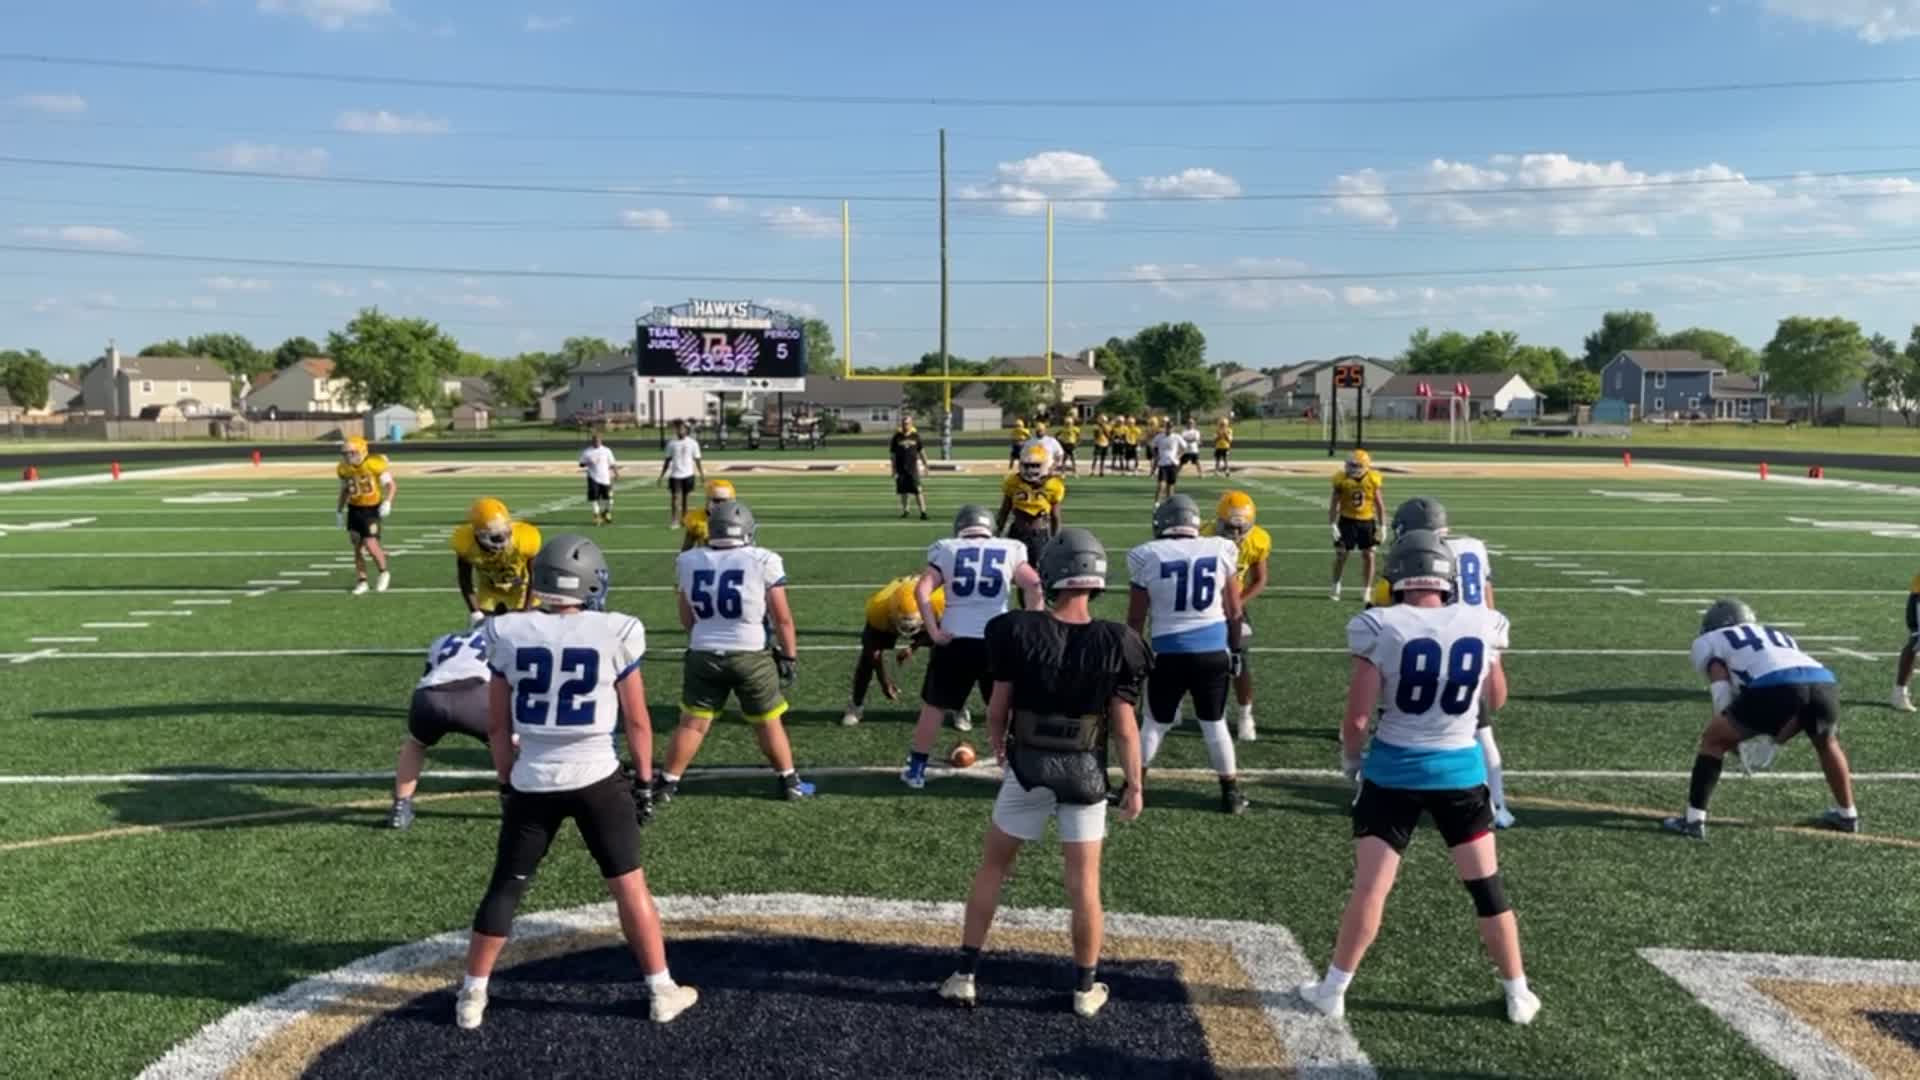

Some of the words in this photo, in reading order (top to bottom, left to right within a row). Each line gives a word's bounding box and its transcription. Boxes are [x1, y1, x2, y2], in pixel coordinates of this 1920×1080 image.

[648, 327, 679, 337] TEAM
[694, 301, 748, 318] HAWKS
[776, 343, 789, 359] 5
[1335, 366, 1362, 386] 25
[691, 569, 744, 619] 56
[952, 548, 1007, 597] 55
[1160, 556, 1218, 612] 76
[515, 647, 600, 726] 22
[1395, 637, 1485, 716] 88
